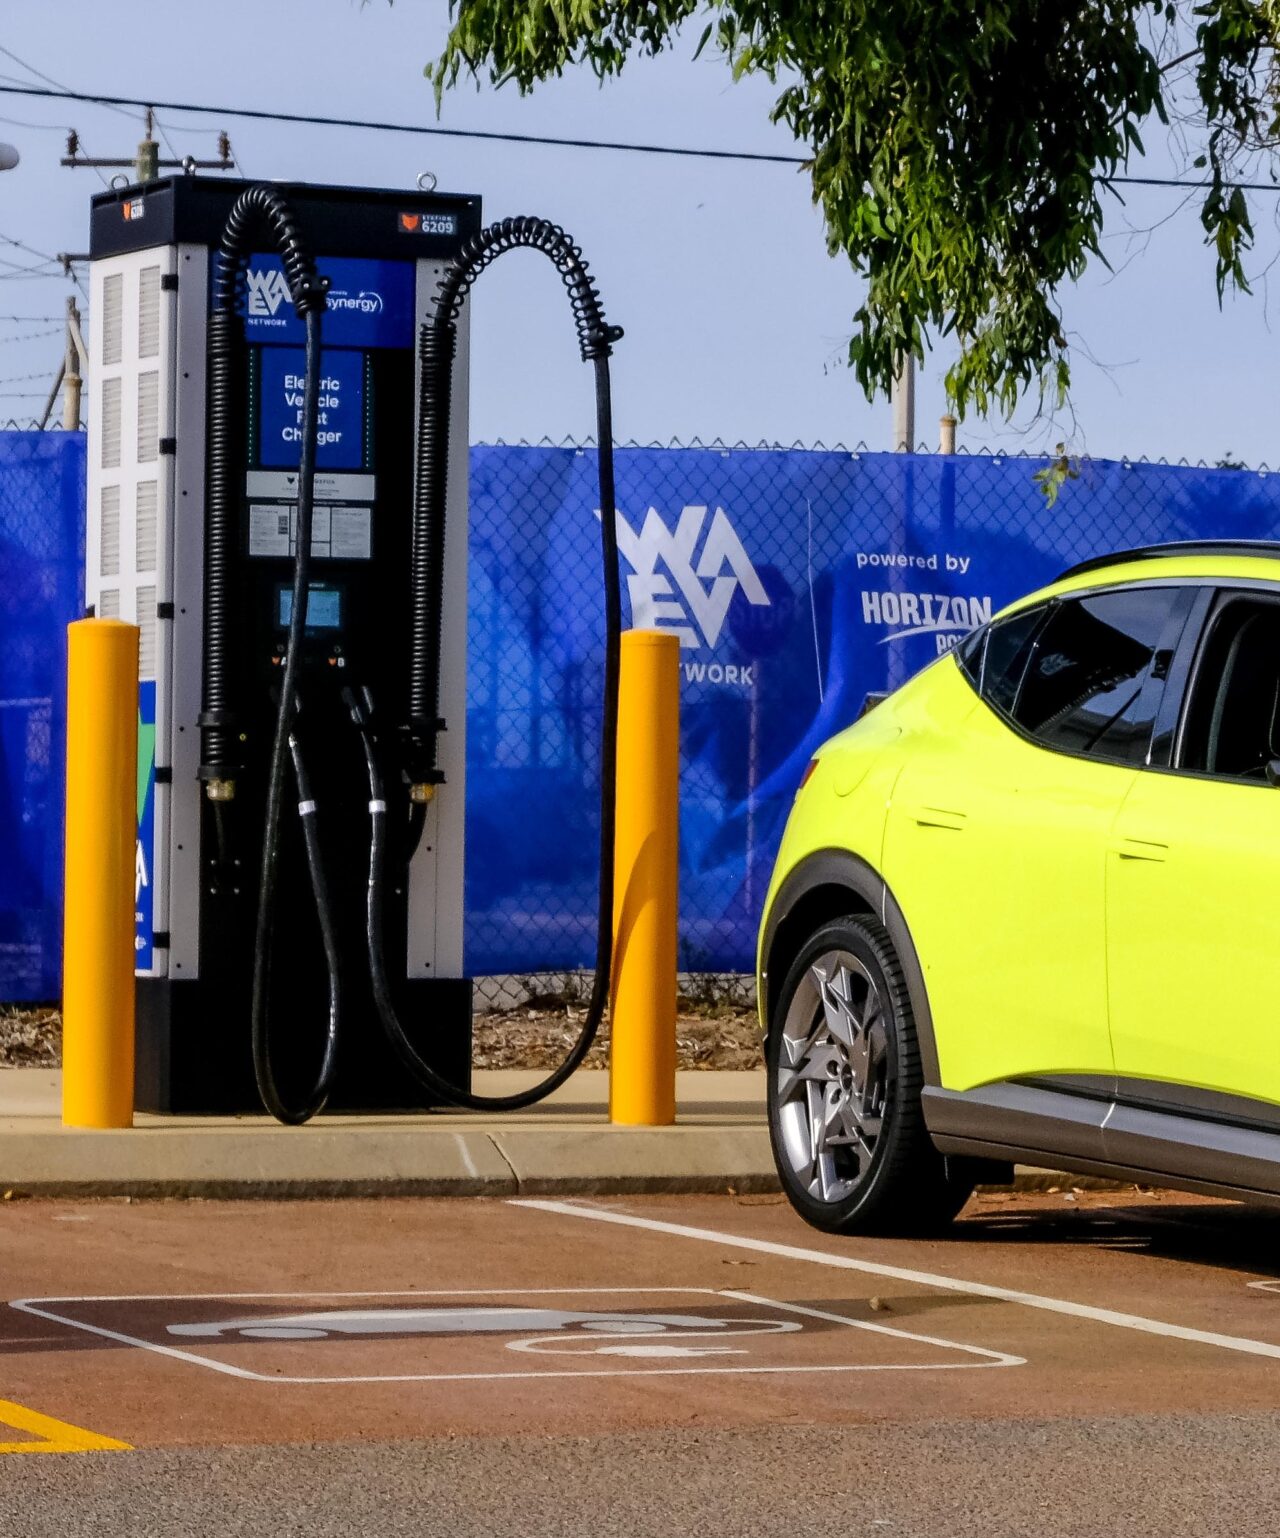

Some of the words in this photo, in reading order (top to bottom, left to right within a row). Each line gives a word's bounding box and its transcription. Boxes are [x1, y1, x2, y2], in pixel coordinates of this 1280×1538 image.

[422, 221, 453, 235] 6209
[248, 318, 287, 327] NETWORK
[284, 375, 340, 391] Eleric
[284, 392, 340, 409] Vecle
[281, 427, 342, 446] Chger
[857, 553, 938, 570] powered
[945, 553, 971, 574] by
[861, 591, 992, 629] HORIZON
[679, 663, 753, 685] WORK
